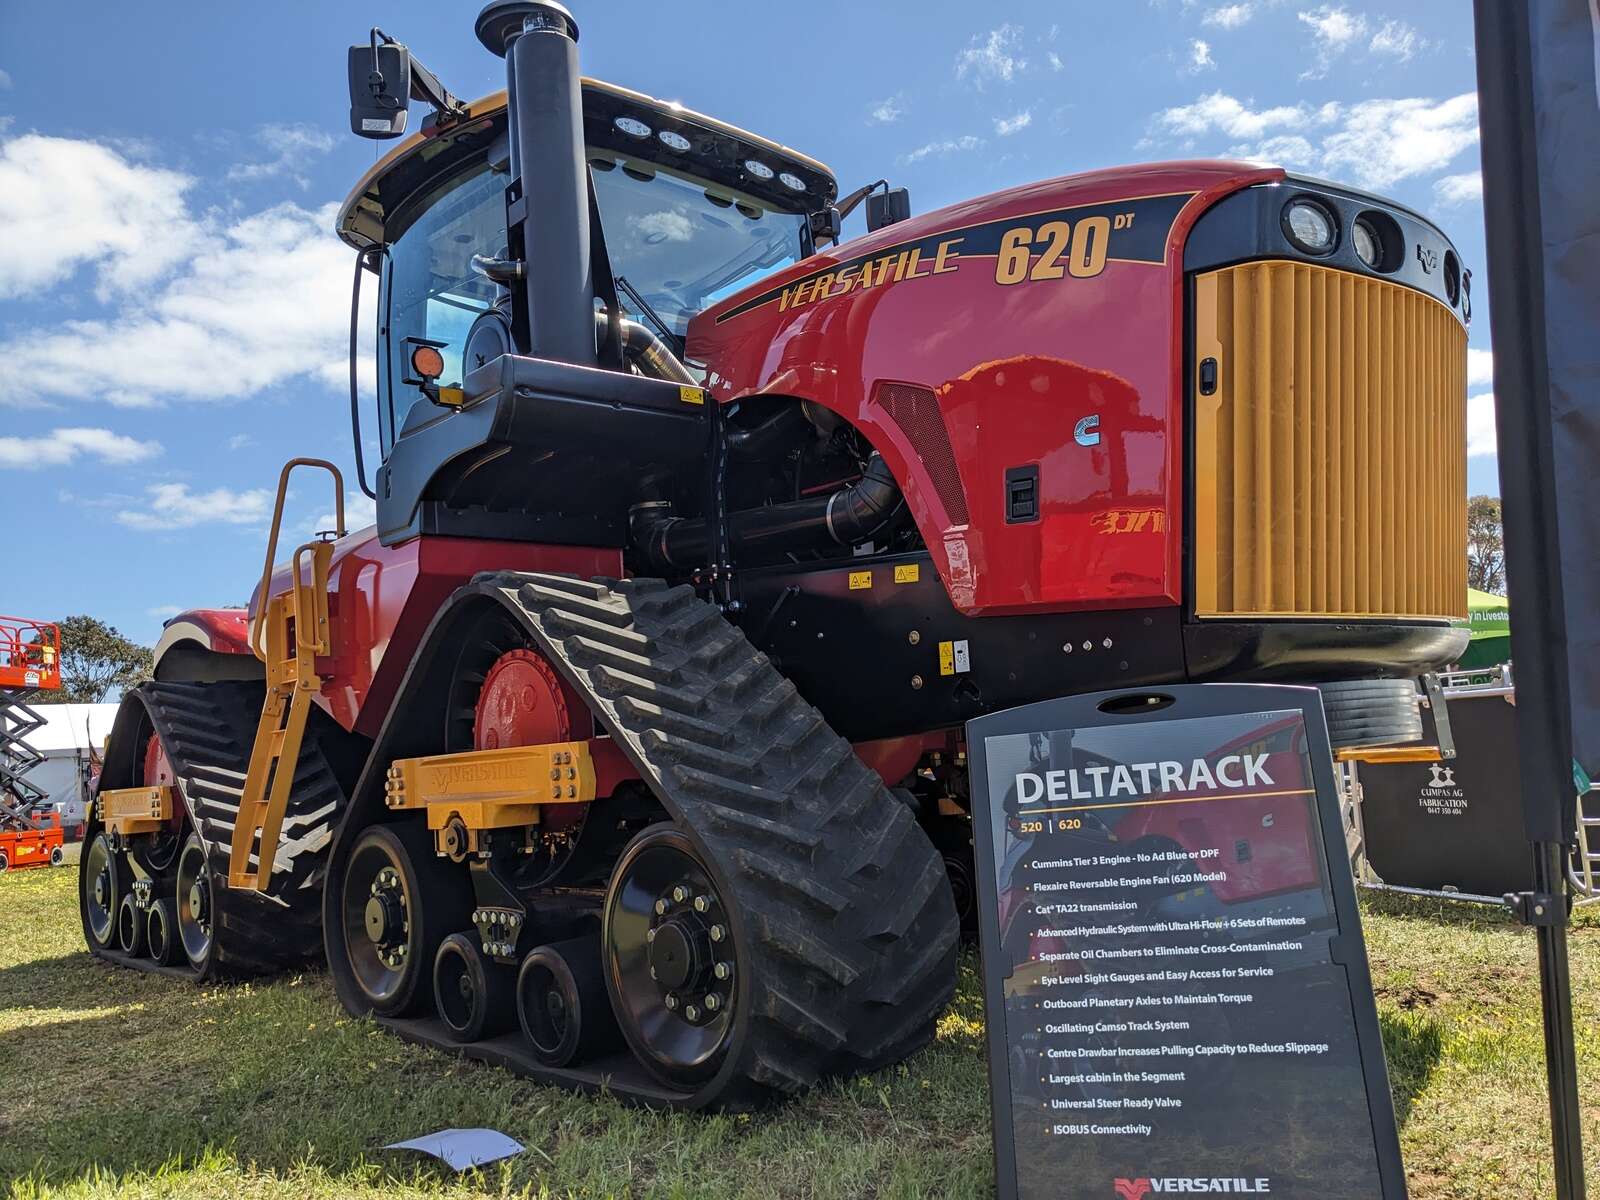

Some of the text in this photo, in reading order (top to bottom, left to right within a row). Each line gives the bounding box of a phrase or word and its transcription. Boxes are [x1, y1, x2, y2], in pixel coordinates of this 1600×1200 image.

[778, 213, 1135, 313] VERSATILE 620 DT
[1474, 611, 1482, 620] in
[1015, 753, 1275, 804] DELTATRACK
[1421, 788, 1463, 797] CUMPAS AG
[1418, 798, 1468, 808] FABRICATION
[1020, 821, 1042, 833] 520
[1058, 818, 1081, 830] 620
[1032, 858, 1073, 869] Cummins
[1073, 857, 1091, 866] Tier
[1092, 856, 1098, 865] 3
[1100, 854, 1131, 866] Engine
[1137, 853, 1151, 863] No
[1152, 852, 1165, 861] Ad
[1166, 851, 1188, 860] Blue
[1200, 849, 1220, 858] DPF
[1034, 872, 1226, 892] Flexaire Reversable Engine Fan (620 Model)
[1056, 903, 1079, 913] TA22
[1080, 901, 1138, 912] transmission
[1037, 926, 1078, 938] Advanced
[1078, 925, 1117, 937] Hydraulic
[1118, 924, 1148, 934] System
[1148, 922, 1167, 932] with
[1168, 920, 1190, 931] Ultra
[1190, 919, 1223, 930] Hi-Flow
[1230, 918, 1236, 928] 6
[1237, 918, 1256, 928] Sets
[1257, 917, 1266, 926] of
[1267, 916, 1306, 926] Remotes
[1039, 940, 1302, 963] Separate Oil Chambers to Eliminate Cross-Contamination
[1042, 966, 1274, 986] Eye Level Sight Gauges and Easy Access for Service
[1043, 993, 1252, 1009] Outboard Planetary Axles to Maintain Torque
[1045, 1021, 1189, 1034] Oscillating Camso Track System
[1047, 1042, 1328, 1058] Centre Drawbar Increases Pulling Capacity to Reduce Slippage
[1049, 1071, 1186, 1086] Largest cabin in the Segment
[1052, 1097, 1182, 1110] Universal Steer Ready Valve
[1053, 1124, 1152, 1136] ISOBUS Connectivity
[1150, 1178, 1270, 1192] VERSATILE
